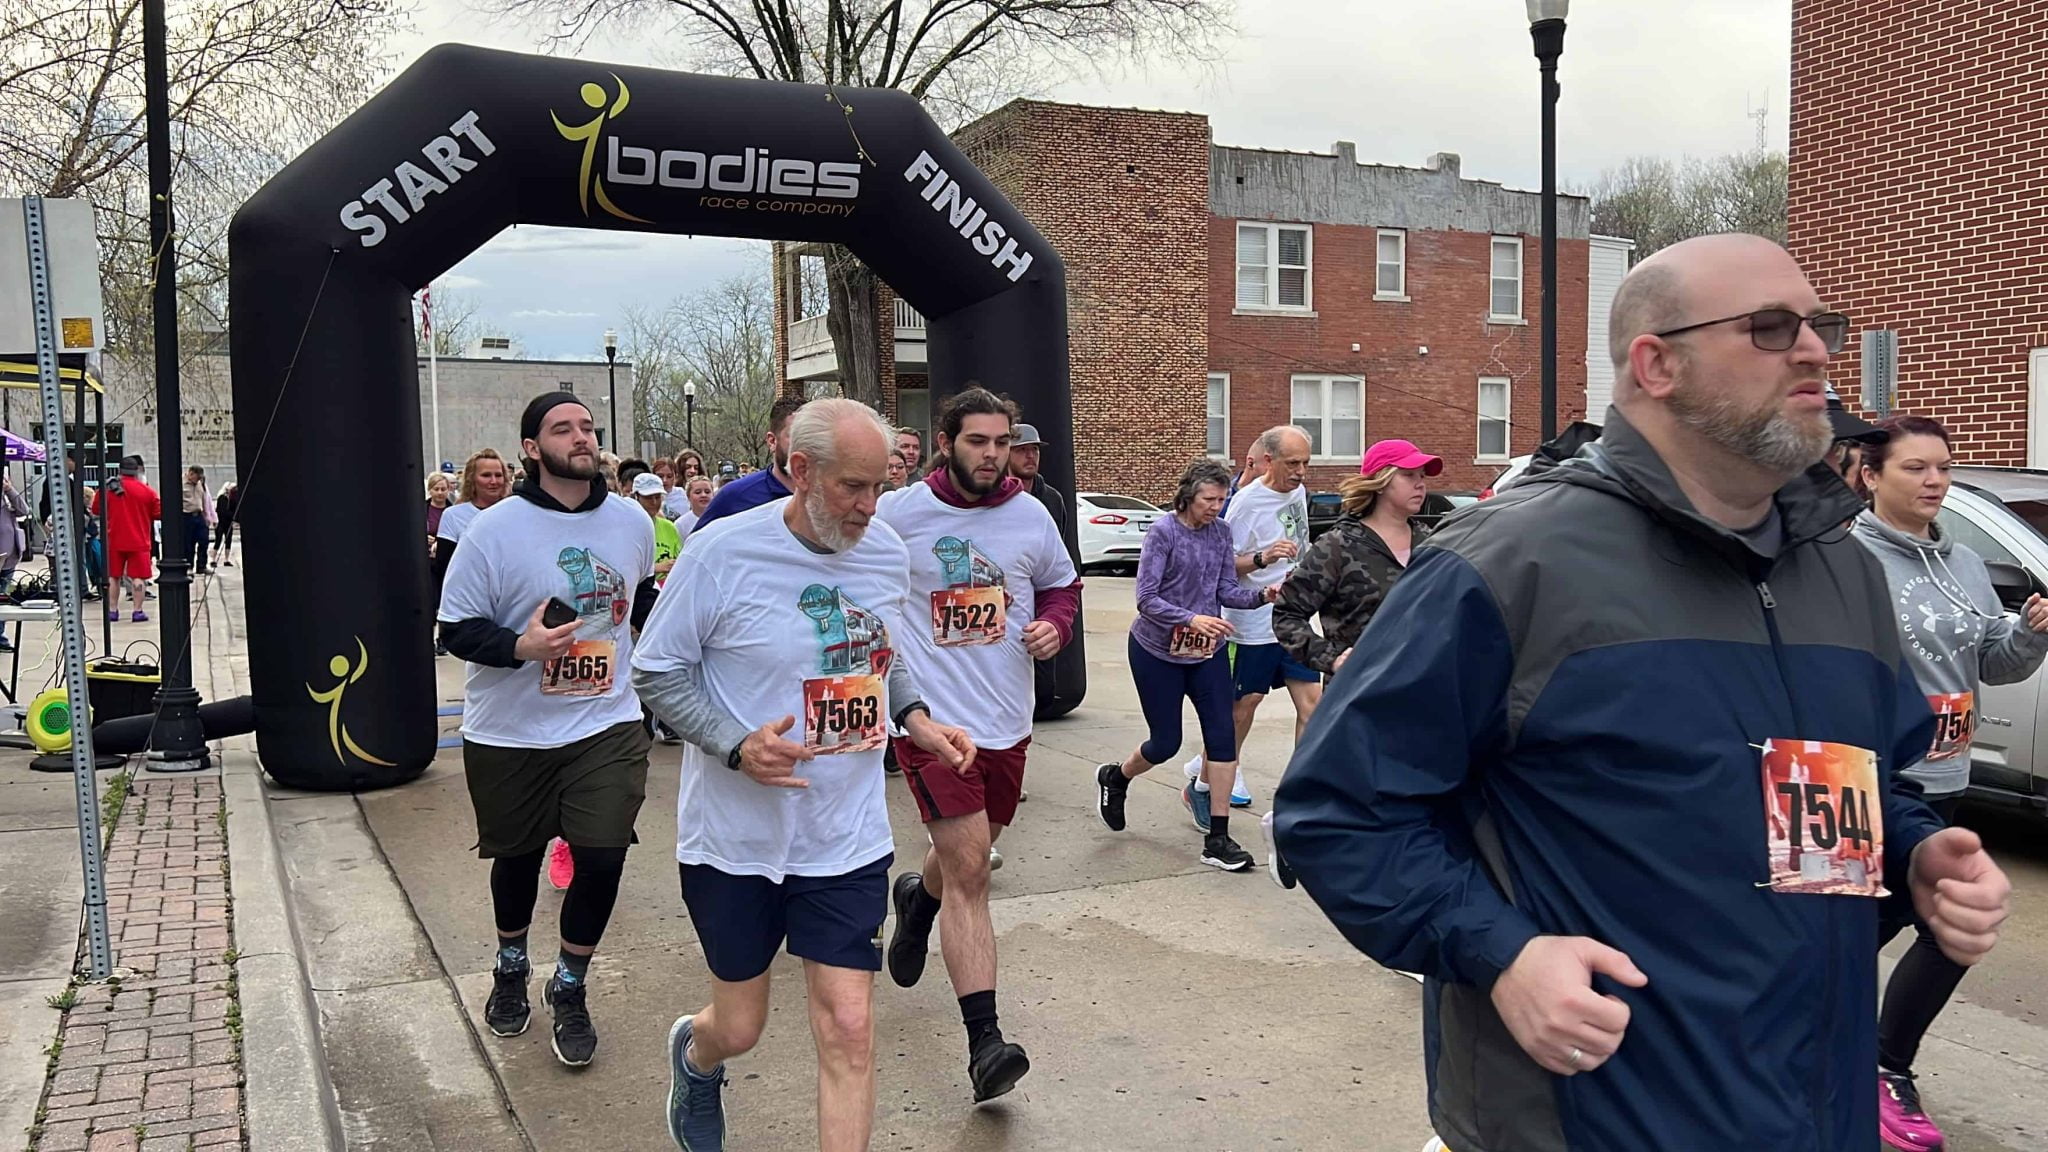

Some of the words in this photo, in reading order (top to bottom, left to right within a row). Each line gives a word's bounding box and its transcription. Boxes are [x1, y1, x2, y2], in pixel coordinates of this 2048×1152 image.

[340, 110, 496, 247] START
[607, 136, 861, 198] bodies
[700, 195, 749, 210] race
[756, 199, 855, 217] company
[904, 150, 1033, 282] FINISH
[940, 603, 997, 630] 7522
[1901, 613, 1942, 662] OUTDOOR
[550, 655, 608, 681] 7565
[813, 695, 878, 733] 7563
[1935, 709, 1974, 741] 754
[1778, 782, 1873, 853] 7544
